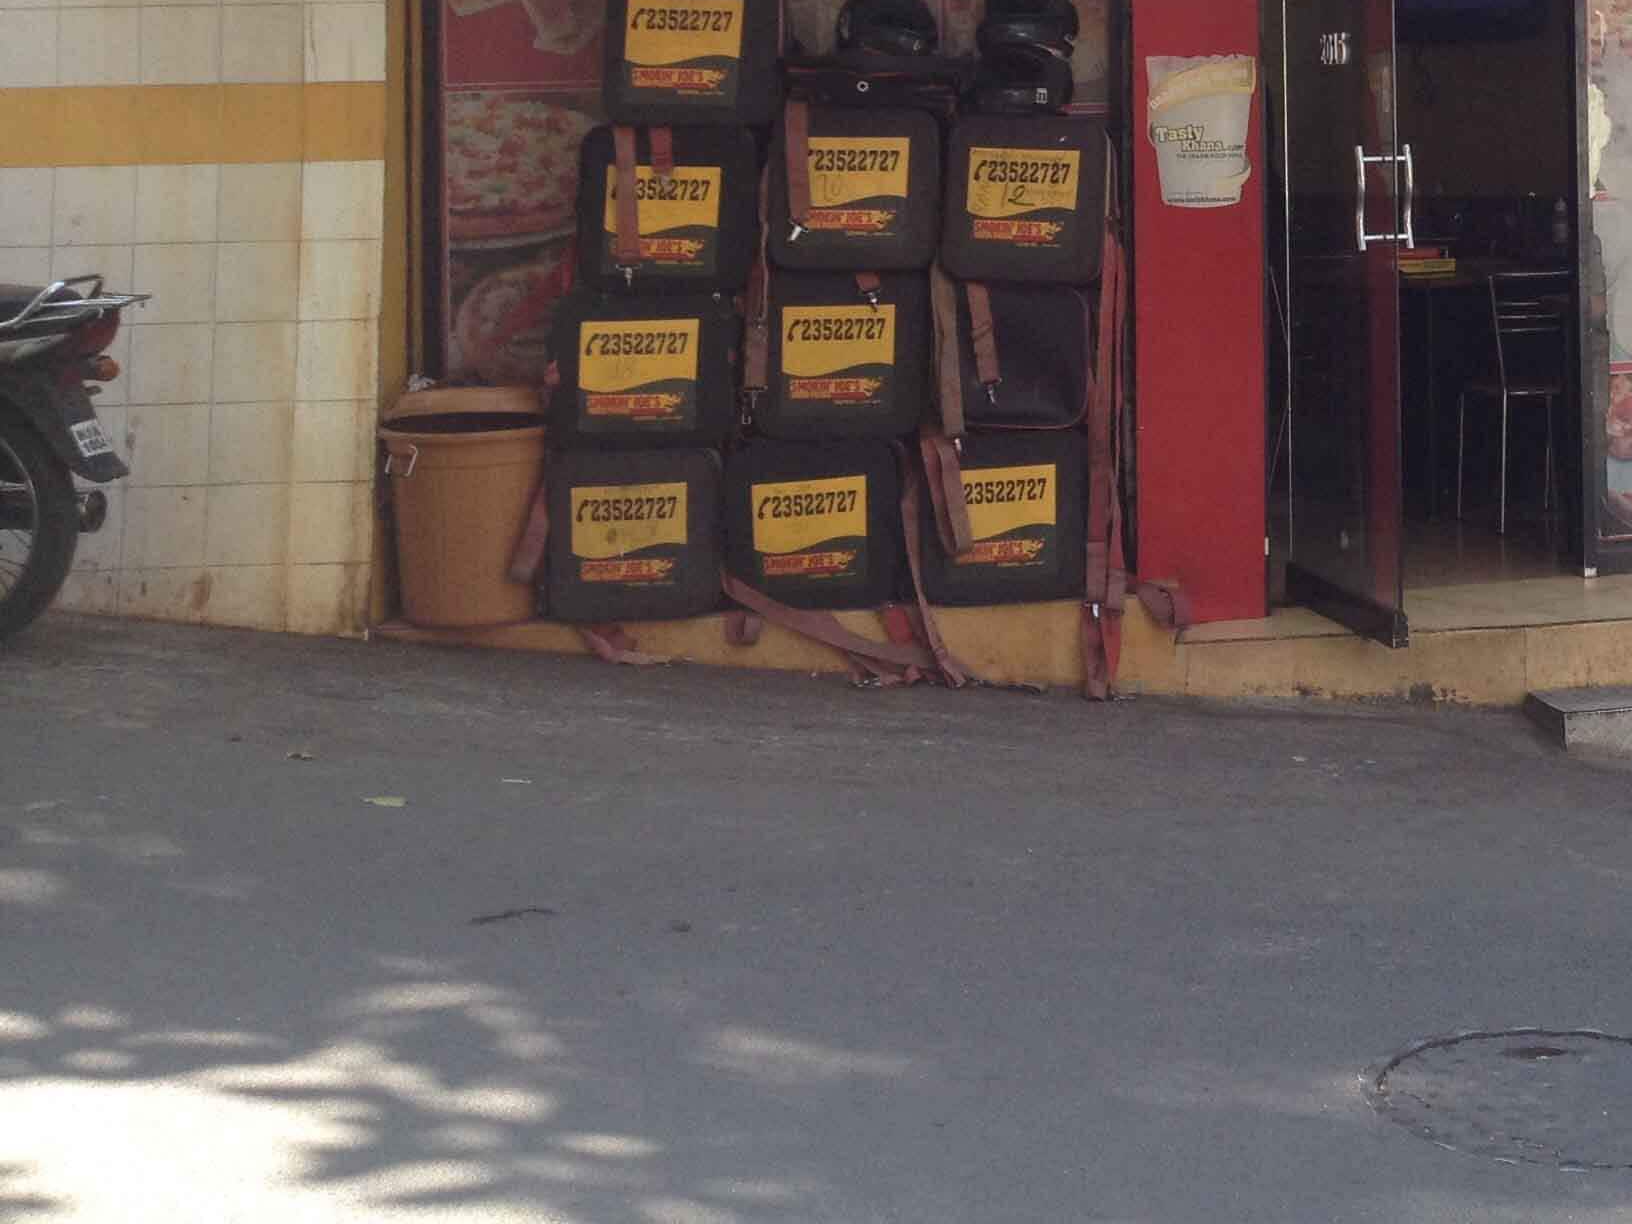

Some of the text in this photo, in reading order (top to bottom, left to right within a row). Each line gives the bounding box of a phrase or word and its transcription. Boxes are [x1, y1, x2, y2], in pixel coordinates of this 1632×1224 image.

[646, 7, 733, 32] 23522727
[815, 149, 900, 172] 23522727
[988, 160, 1071, 184] 23522727
[800, 317, 886, 342] 23522727
[600, 332, 688, 356] 23522727
[963, 477, 1047, 504] 23522727
[591, 495, 677, 522] 23522727
[772, 490, 857, 518] 23522727
